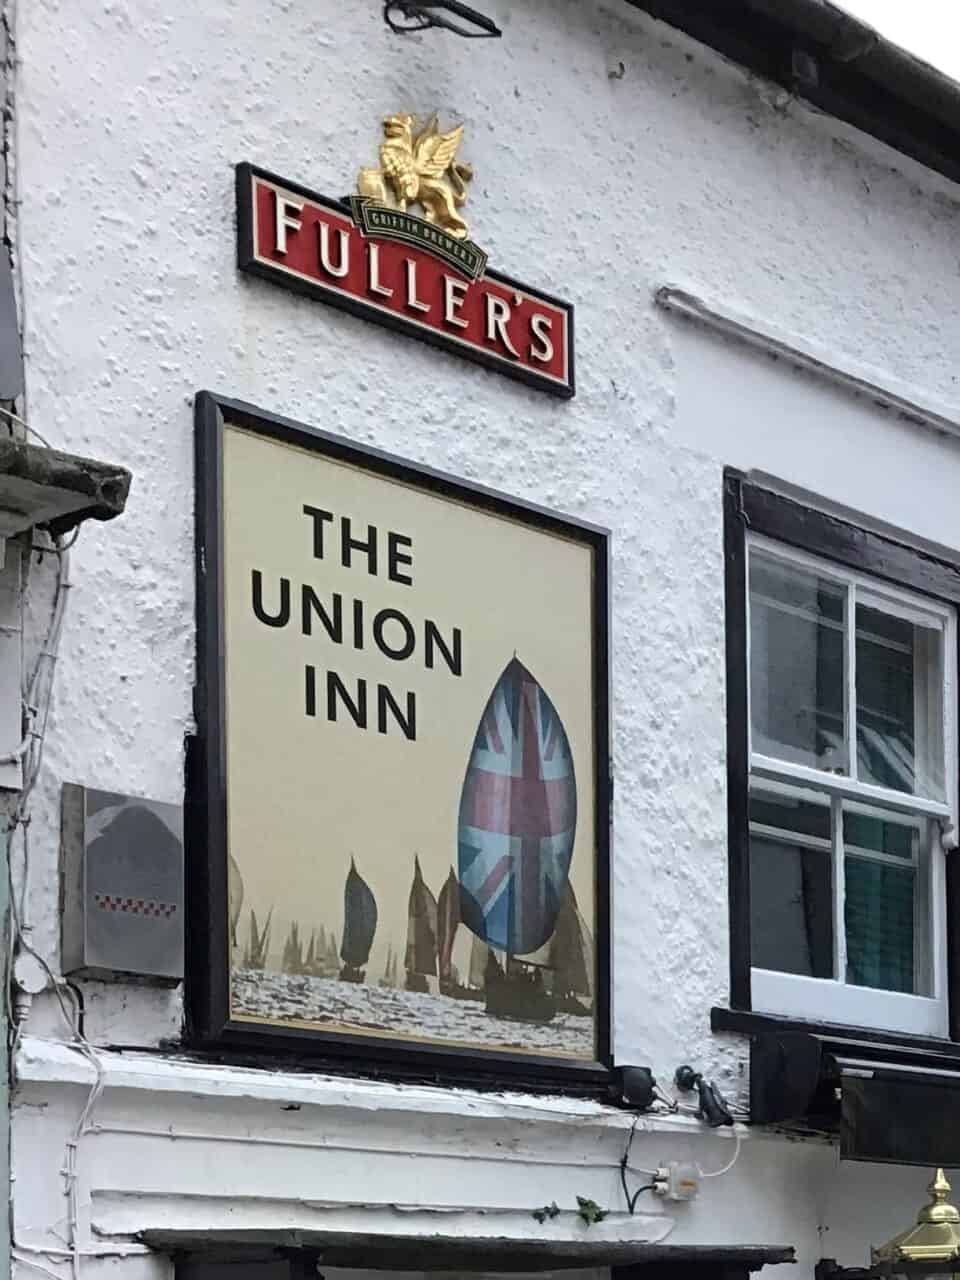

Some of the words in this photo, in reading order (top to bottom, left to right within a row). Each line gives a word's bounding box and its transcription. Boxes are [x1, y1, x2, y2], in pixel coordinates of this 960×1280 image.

[271, 189, 554, 363] FULLER'S
[372, 212, 419, 233] GRIFFIN
[423, 224, 474, 265] BREWERY
[303, 504, 413, 586] THE
[251, 570, 462, 676] UNION
[305, 665, 416, 741] INN
